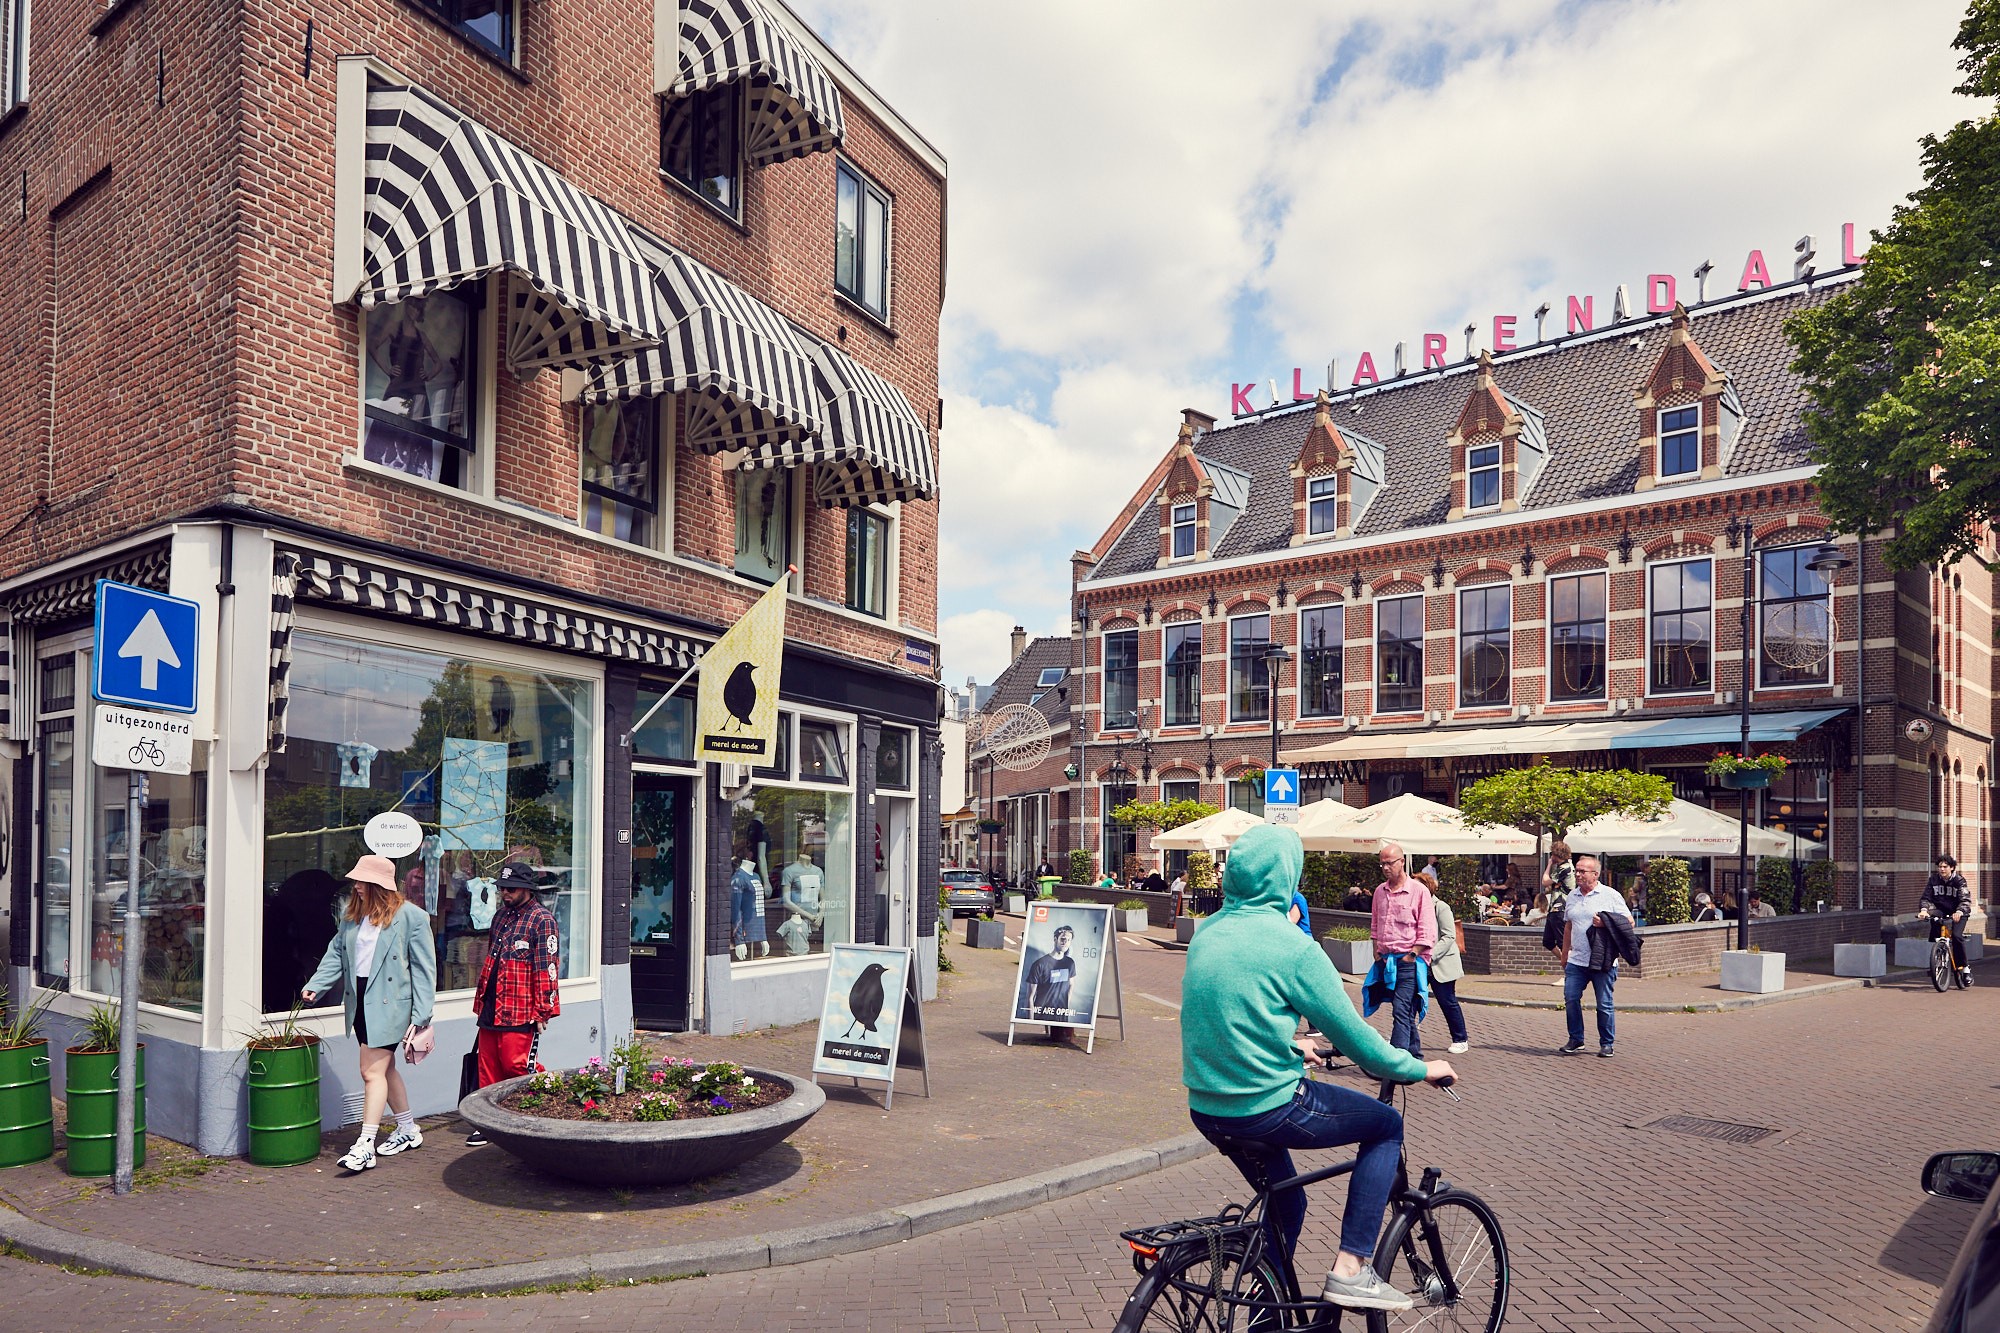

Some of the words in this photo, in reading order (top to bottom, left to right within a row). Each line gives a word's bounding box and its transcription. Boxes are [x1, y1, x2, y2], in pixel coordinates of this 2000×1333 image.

[1231, 222, 1867, 416] KLARENDAL
[106, 712, 189, 735] uitgezonderd
[711, 740, 730, 749] merel
[731, 741, 740, 749] de
[740, 742, 759, 751] mode
[1082, 947, 1097, 959] BG
[1042, 1007, 1056, 1016] ARE
[1056, 1007, 1077, 1017] OPEN!
[832, 1047, 851, 1056] merel
[853, 1049, 862, 1057] de
[863, 1051, 882, 1060] mode
